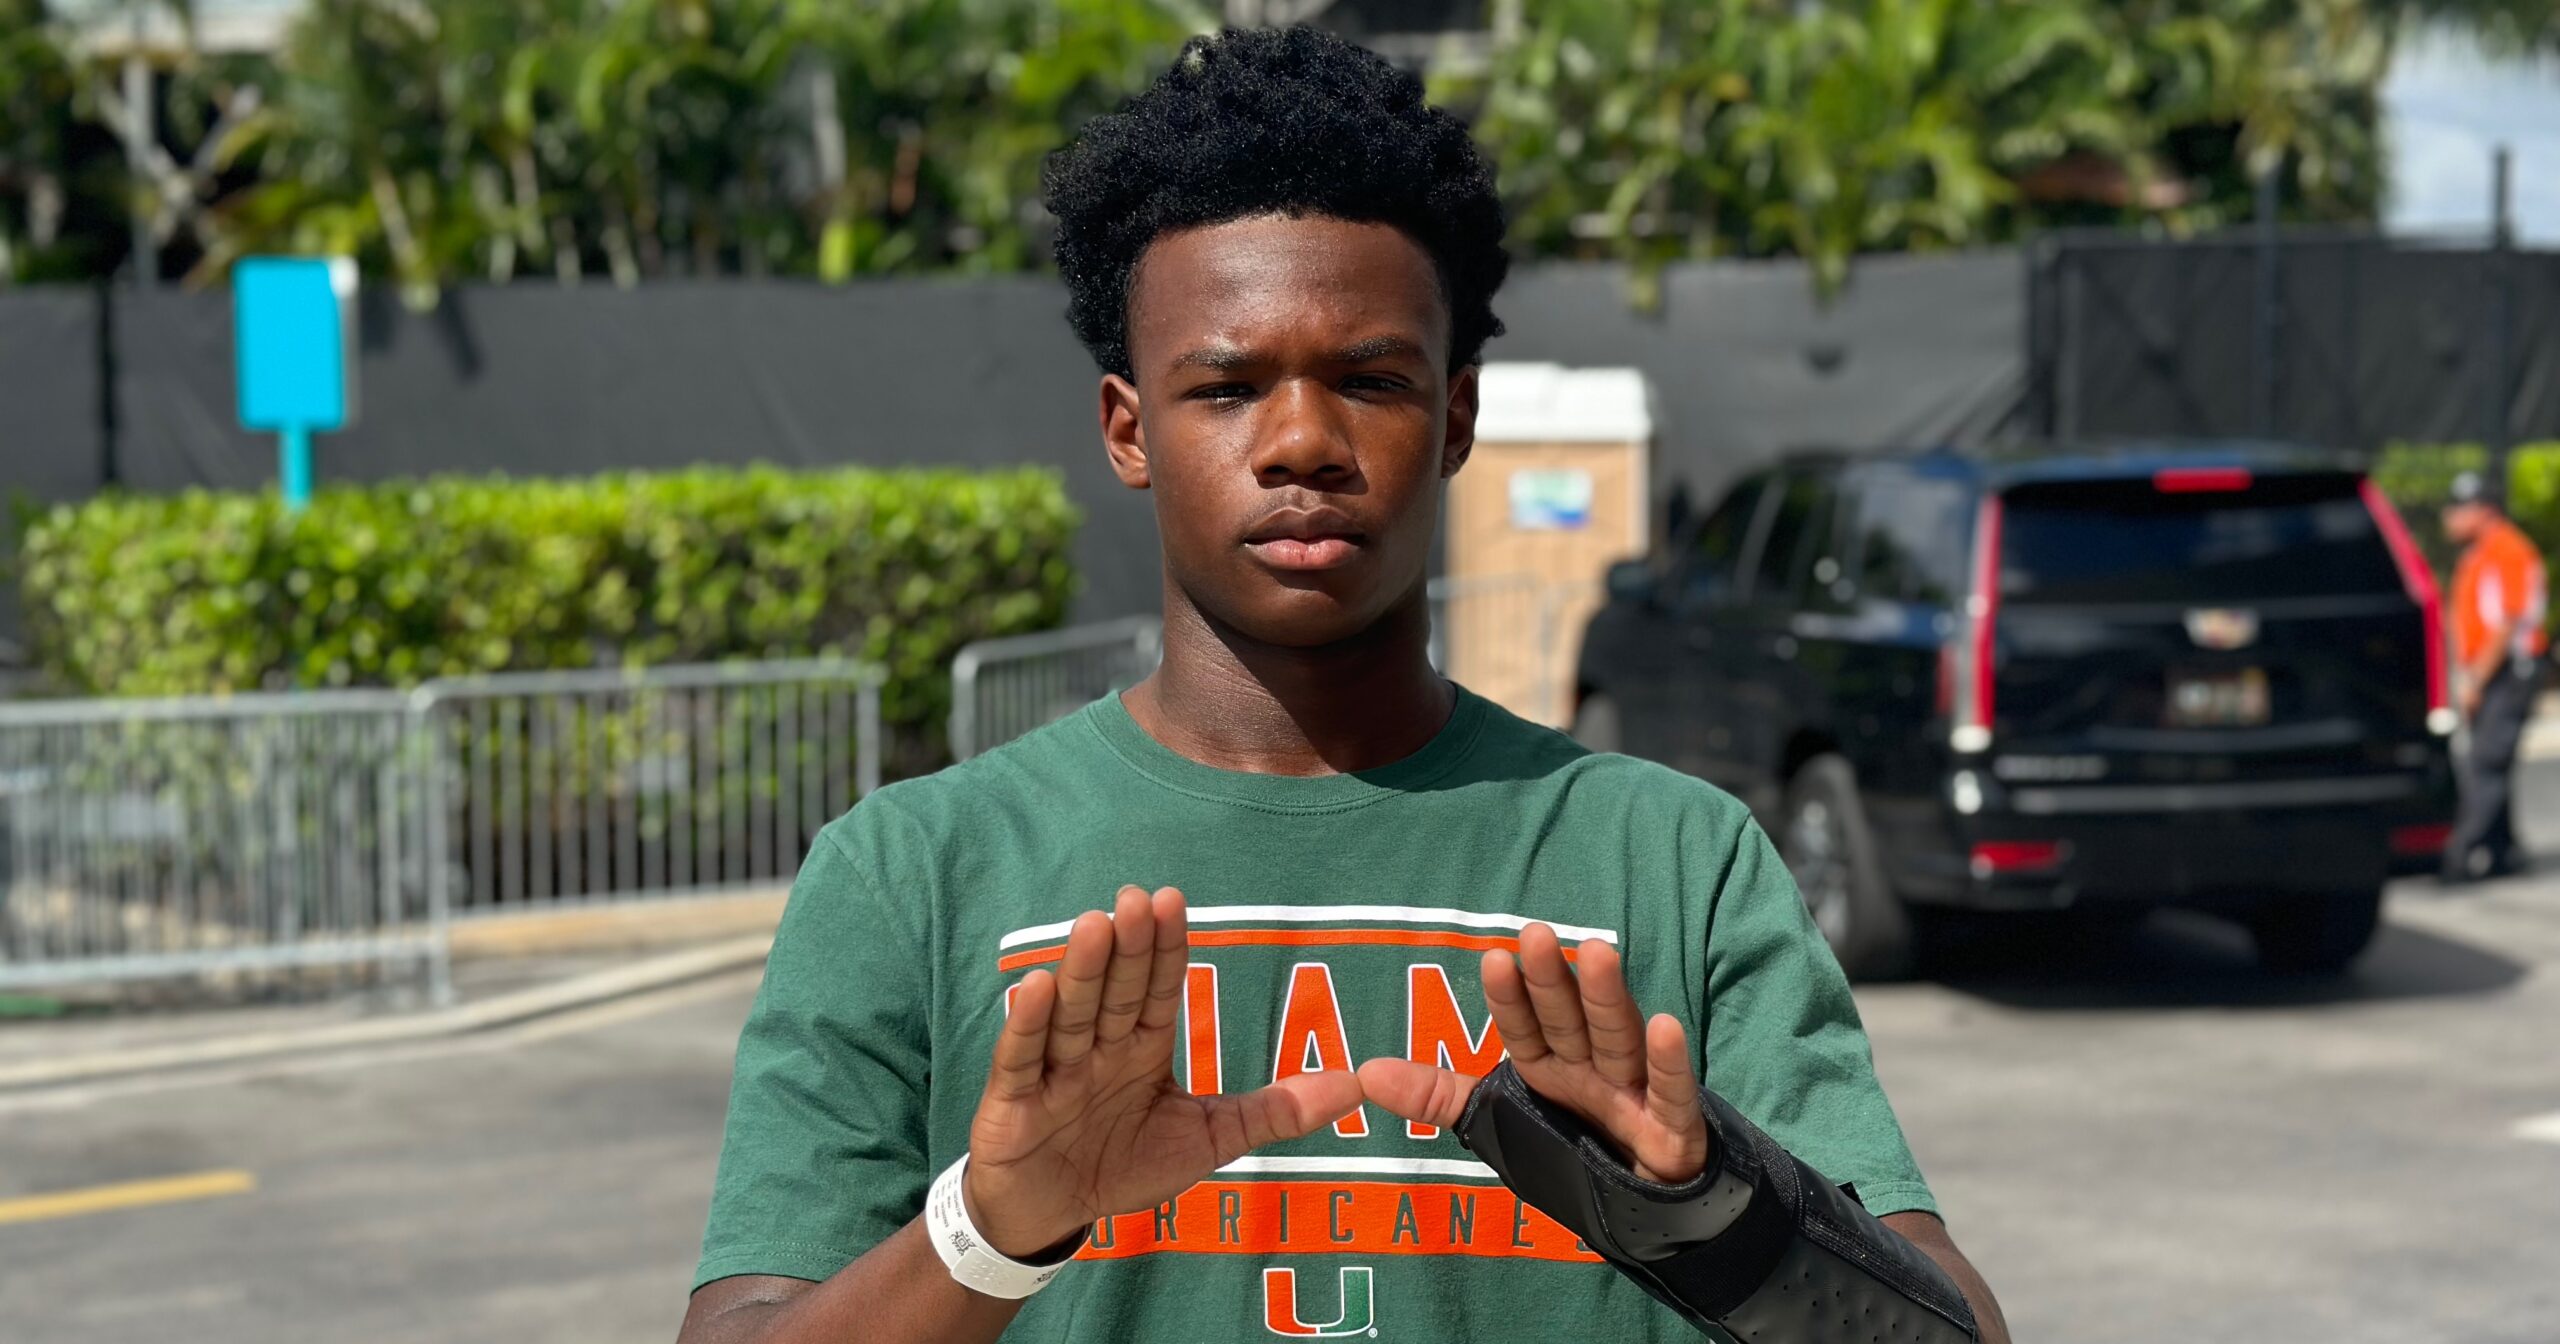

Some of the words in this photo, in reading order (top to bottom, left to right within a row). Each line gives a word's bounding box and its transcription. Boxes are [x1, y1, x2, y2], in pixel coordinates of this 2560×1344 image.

[1005, 963, 1511, 1139] IAM
[1089, 1189, 1594, 1254] URRICANE
[1263, 1266, 1374, 1337] U
